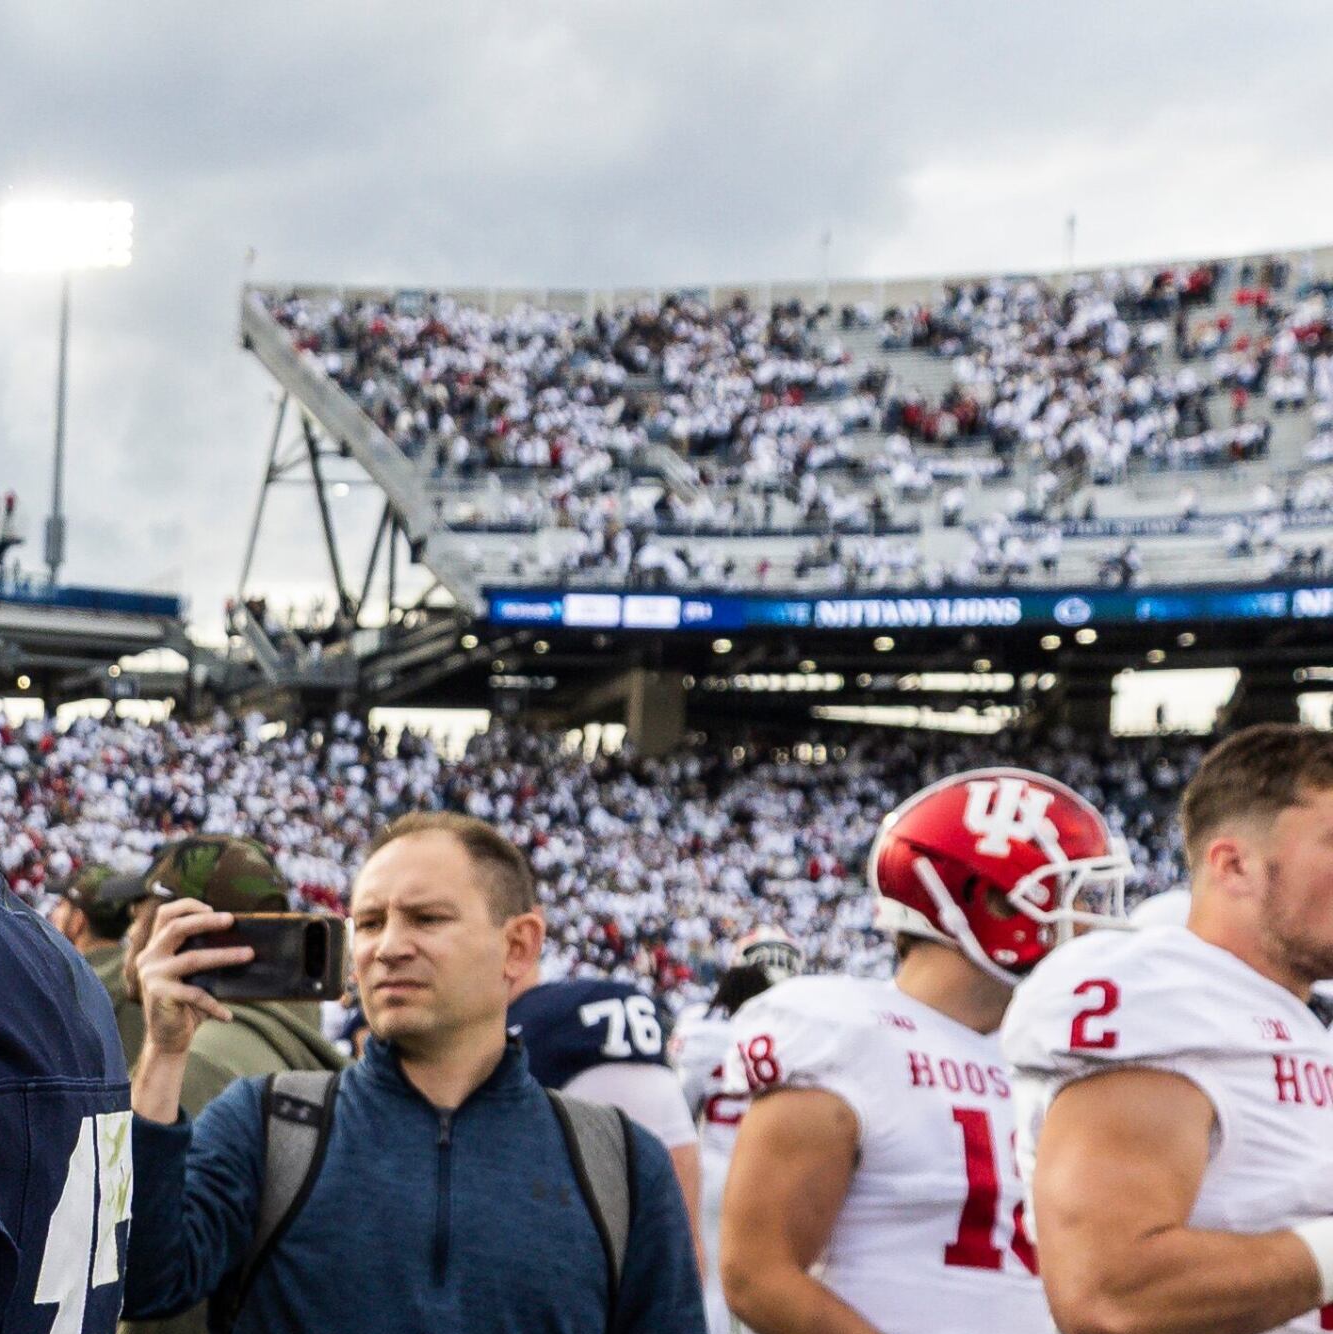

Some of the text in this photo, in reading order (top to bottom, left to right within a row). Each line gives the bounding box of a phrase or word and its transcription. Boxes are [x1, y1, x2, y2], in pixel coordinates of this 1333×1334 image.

[579, 995, 661, 1057] 76
[1070, 979, 1121, 1049] 2
[737, 1034, 780, 1091] 18
